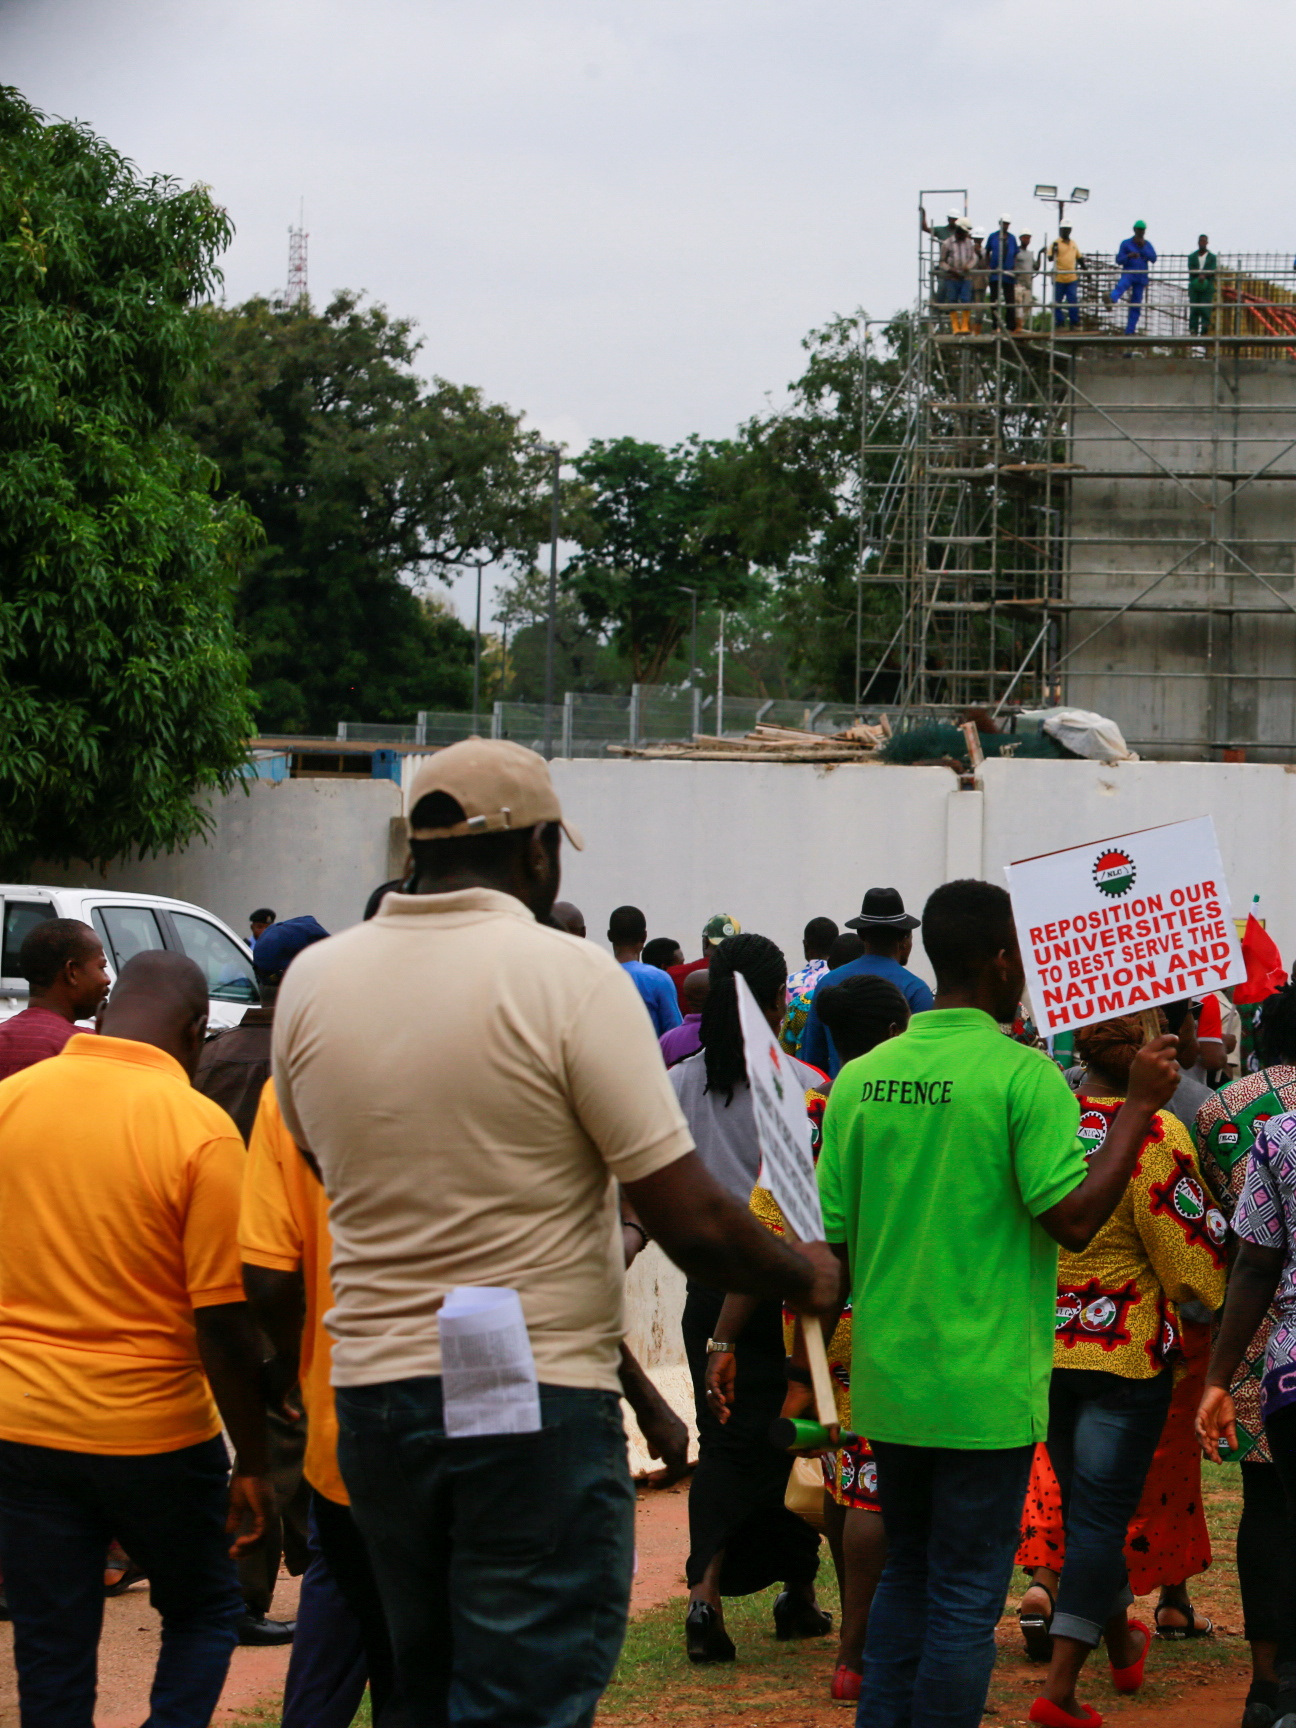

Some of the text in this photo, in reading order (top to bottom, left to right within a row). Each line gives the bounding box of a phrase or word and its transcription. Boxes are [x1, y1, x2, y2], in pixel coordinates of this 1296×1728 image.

[1107, 869, 1123, 878] NLC
[1029, 880, 1219, 946] REPOSITION OUR
[1033, 900, 1223, 966] UNIVERSITIES
[1037, 919, 1228, 986] TO BEST SERVE THE
[1042, 941, 1231, 1008] NATION AND
[1046, 960, 1232, 1028] HUMANITY
[860, 1079, 954, 1105] DEFENCE
[1083, 1129, 1096, 1138] NLC
